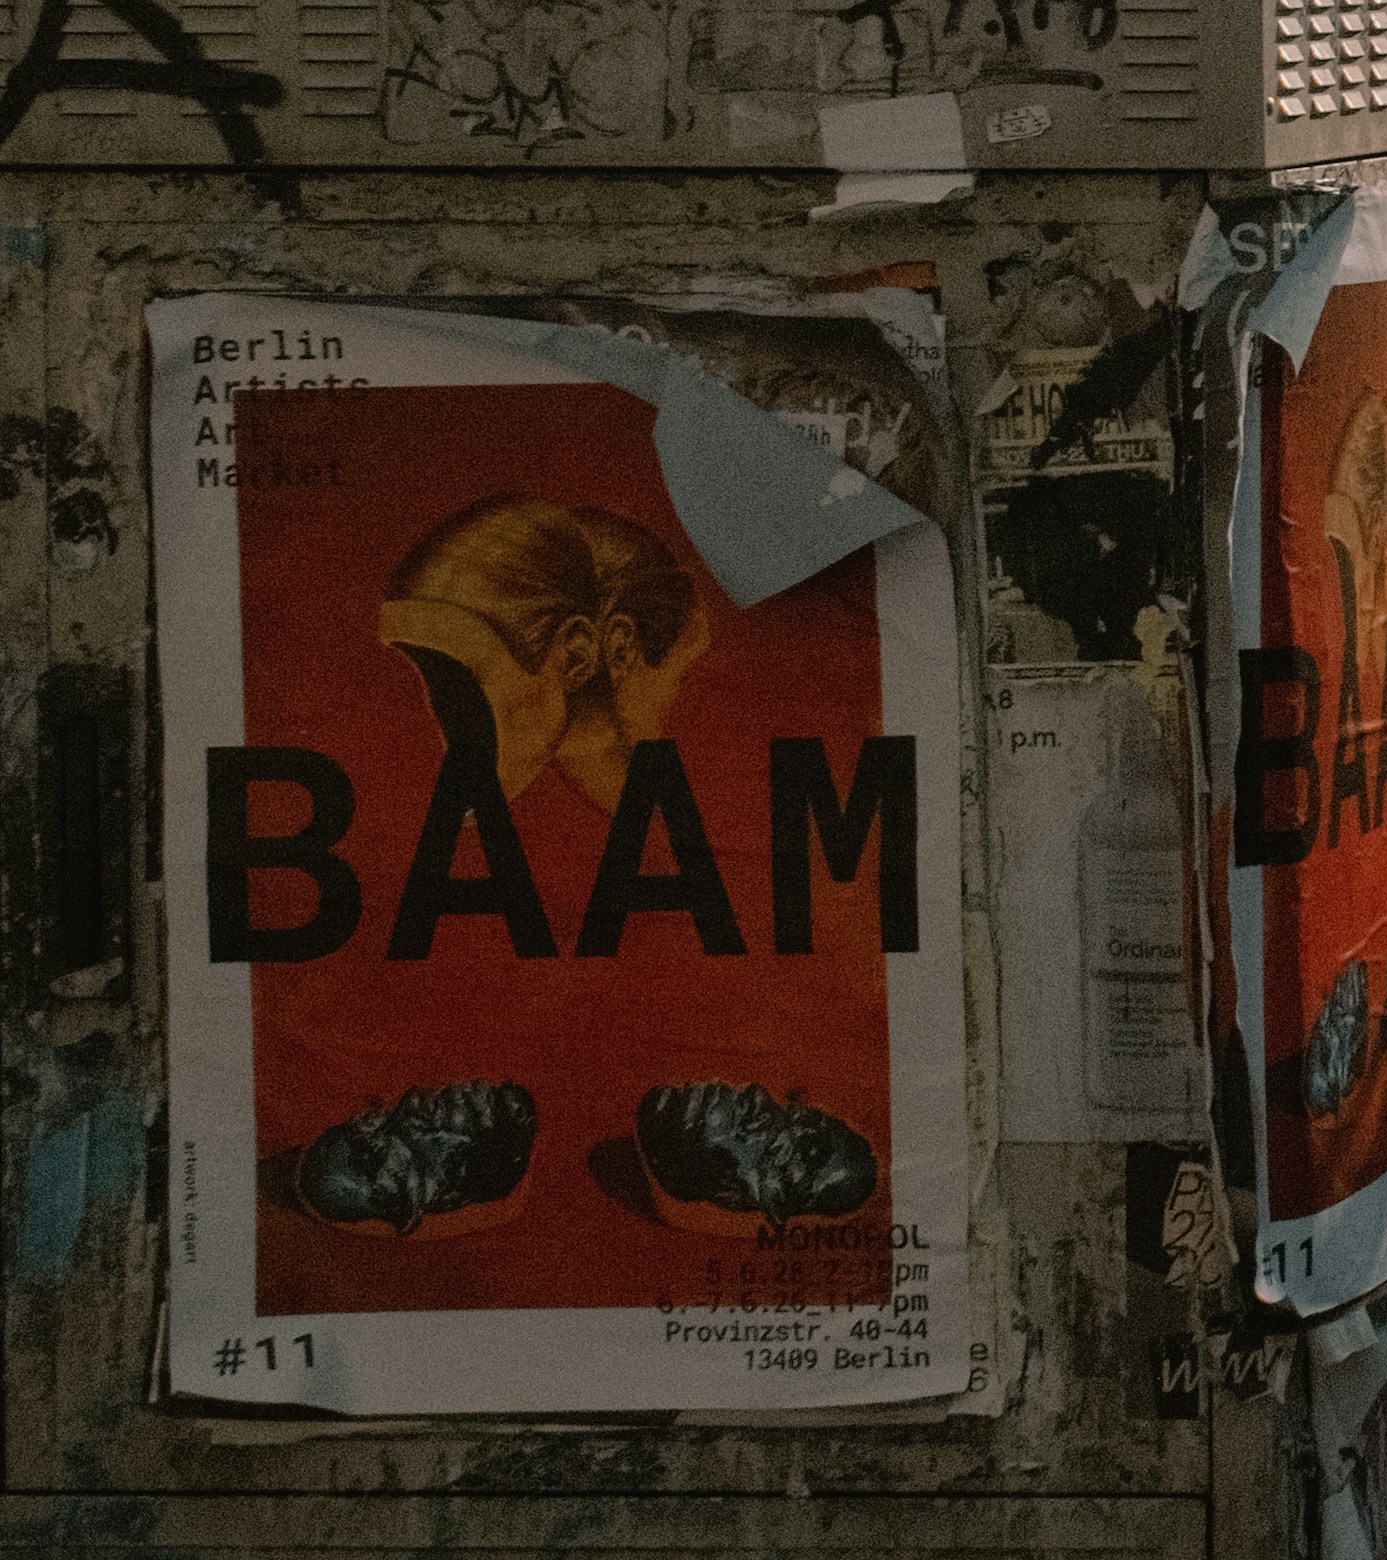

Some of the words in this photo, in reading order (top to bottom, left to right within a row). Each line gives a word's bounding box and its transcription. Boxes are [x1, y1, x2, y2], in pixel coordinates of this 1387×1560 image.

[192, 329, 344, 365] Berlin
[193, 372, 370, 406] Artists
[194, 416, 268, 447] Art
[196, 456, 346, 488] Market
[206, 735, 921, 963] BAAM
[756, 1224, 930, 1251] MONOPOL
[665, 1321, 833, 1344] Provinzstr.
[850, 1319, 929, 1341] 40-44
[212, 1334, 315, 1376] #11
[743, 1348, 819, 1372] 13409
[834, 1345, 931, 1370] Berlin
